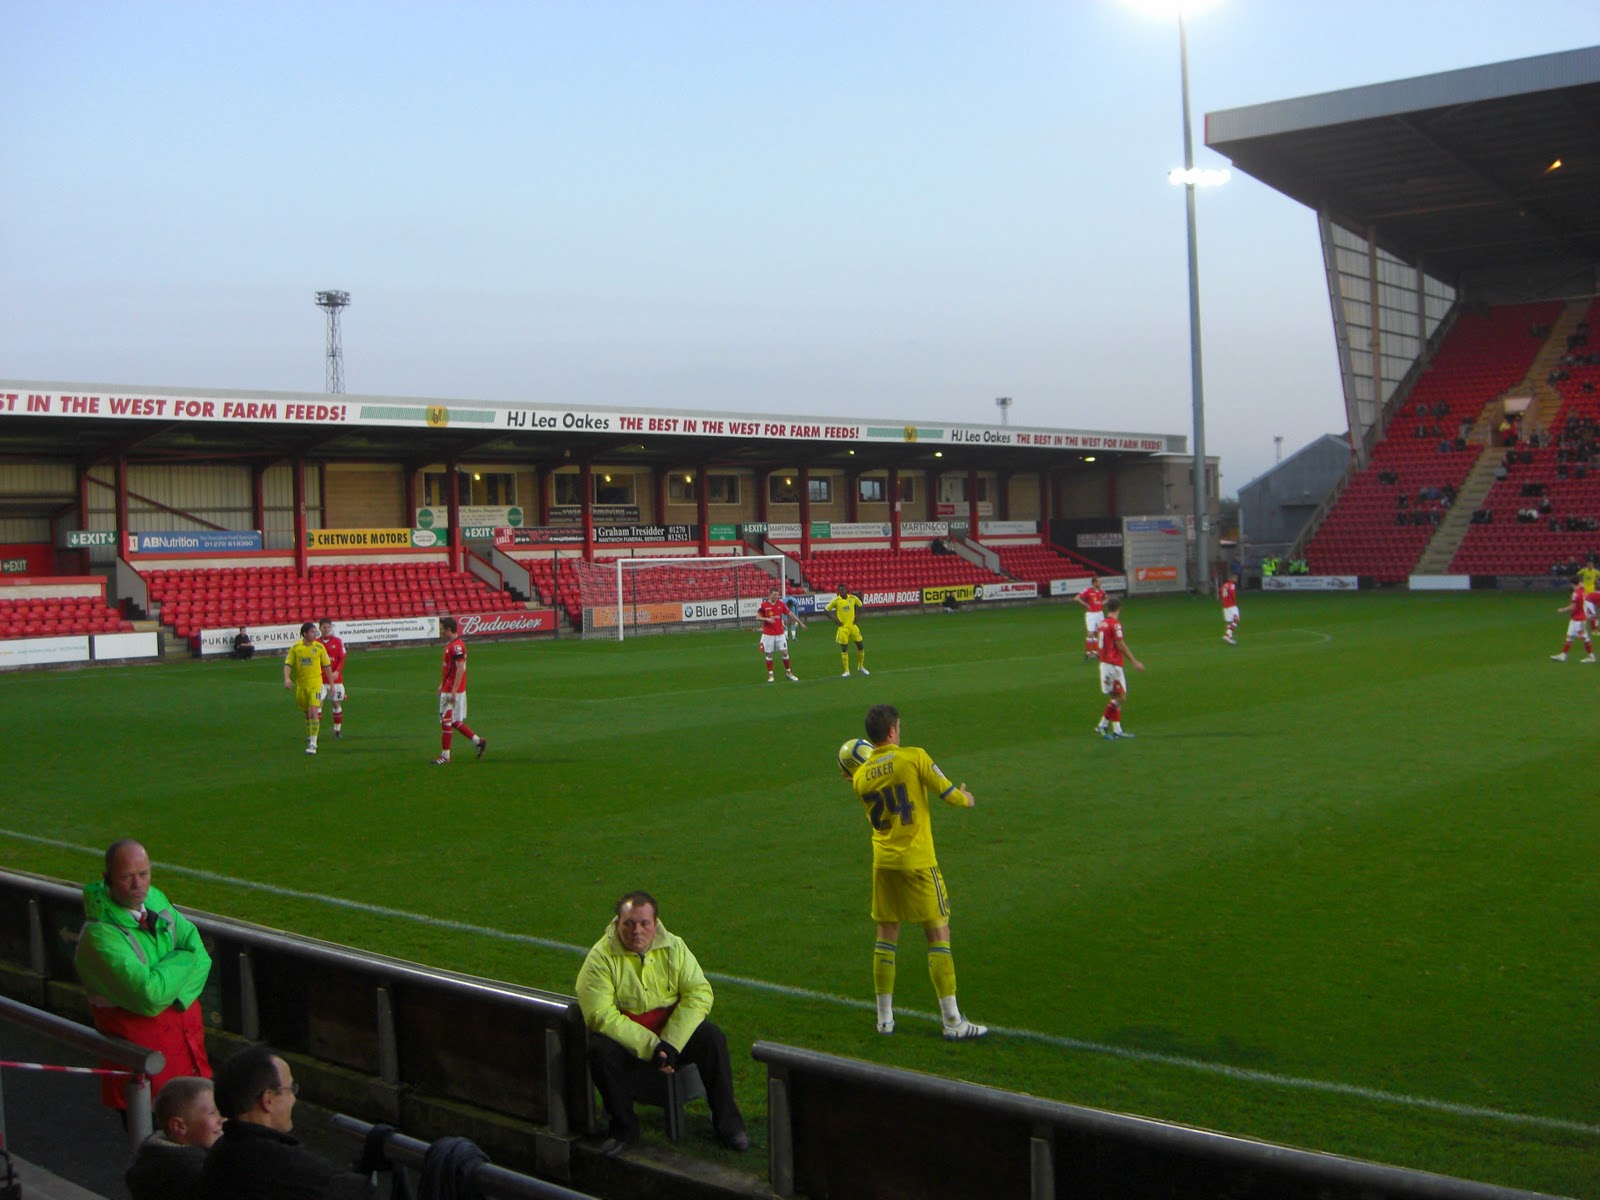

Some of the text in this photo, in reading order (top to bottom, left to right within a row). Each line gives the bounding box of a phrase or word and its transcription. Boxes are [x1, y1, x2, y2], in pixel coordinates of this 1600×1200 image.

[26, 394, 51, 413] IN
[61, 395, 100, 414] THE
[109, 397, 167, 416] WEST
[174, 399, 215, 418] FOR
[222, 402, 277, 420] FARM
[285, 404, 347, 422] FEEDS!
[506, 411, 860, 439] HJ Lea Oakes THE BEST IN THE WEST FOR FARM FEEDS!
[951, 430, 1163, 450] HJ Lea Oakes THE BEST IN THE WEST FOR FARM FEEDS!
[471, 528, 490, 537] EXIT
[598, 526, 686, 536] Graham Tresidder 01270
[749, 524, 763, 533] EXIT
[901, 523, 948, 531] MARTIN&CO
[80, 533, 107, 545] EXIT
[143, 535, 199, 548] ABNutrition
[318, 533, 368, 545] CHETWODE
[370, 532, 408, 544] MOTORS
[667, 533, 688, 541] 812512
[204, 540, 226, 548] 01270
[10, 560, 27, 571] EXIT
[863, 590, 920, 605] BARGAIN BOOZE
[696, 605, 718, 618] Blue
[459, 615, 542, 635] Budweiser
[865, 761, 894, 782] COKER
[861, 782, 914, 831] 24
